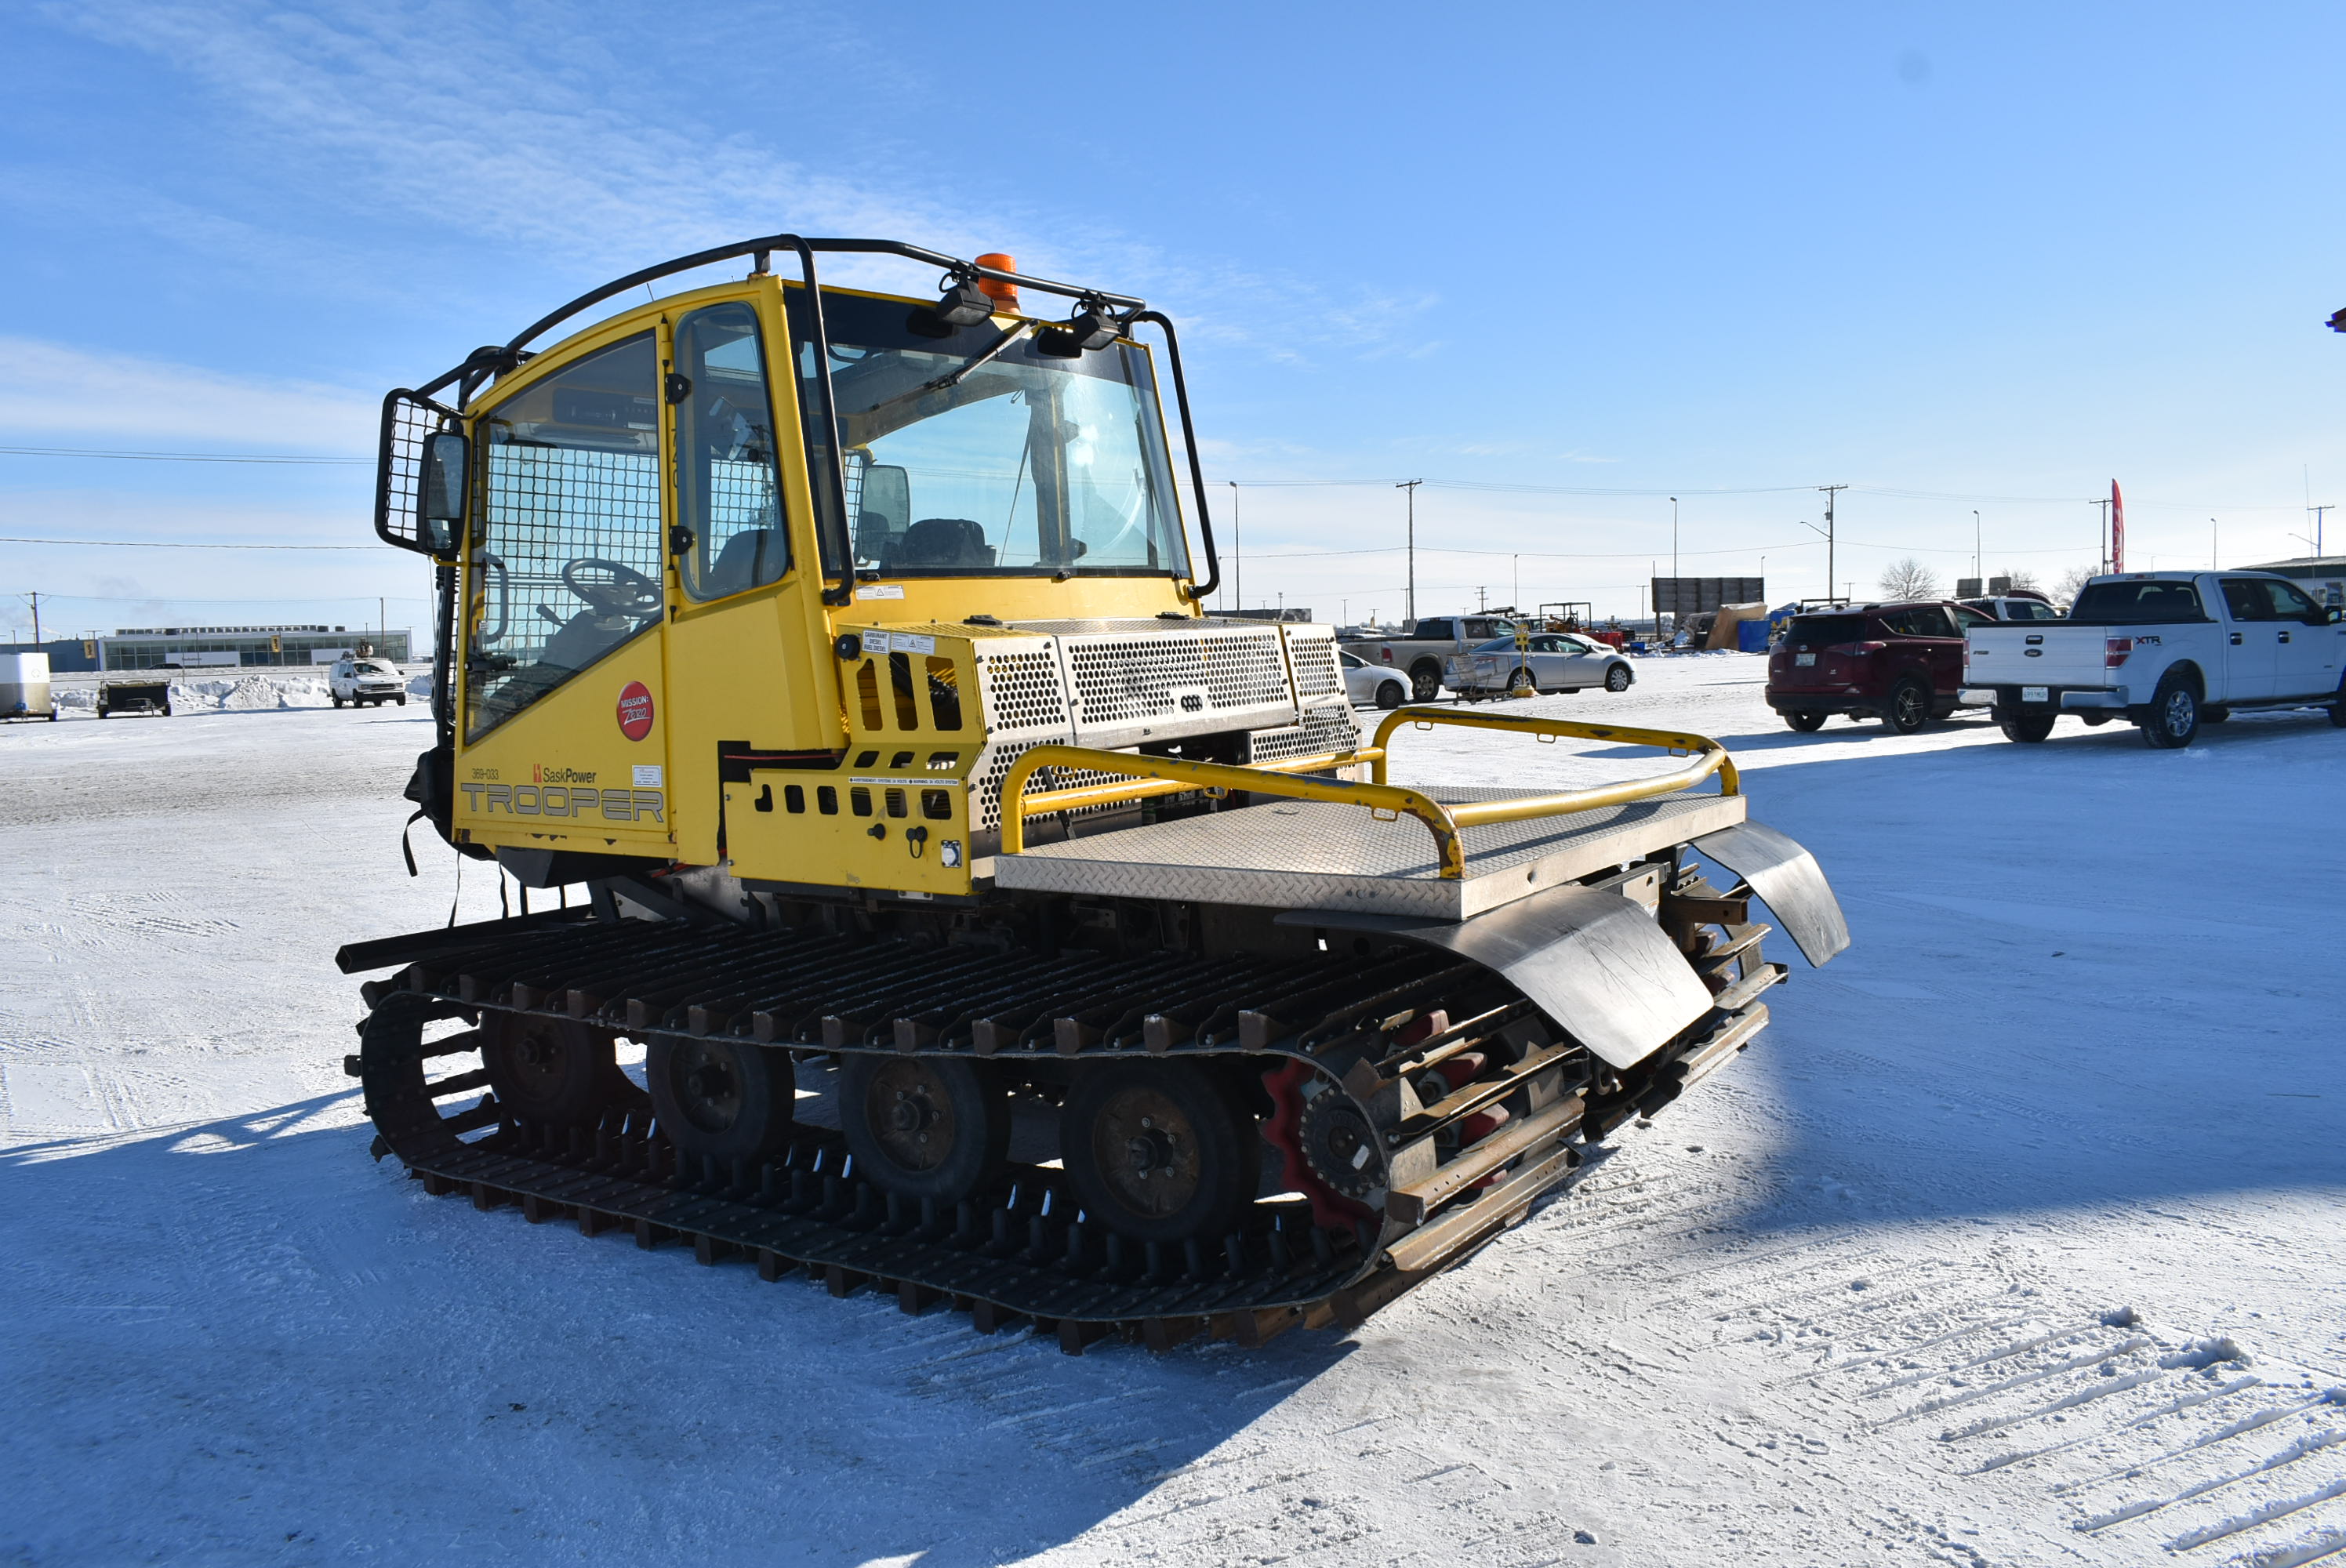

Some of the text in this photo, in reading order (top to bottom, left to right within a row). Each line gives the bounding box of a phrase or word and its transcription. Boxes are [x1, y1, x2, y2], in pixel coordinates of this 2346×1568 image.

[2135, 636, 2161, 644] XTR
[621, 695, 649, 708] MISSION:
[543, 767, 597, 783] SaskPower
[460, 782, 664, 823] TROOPER
